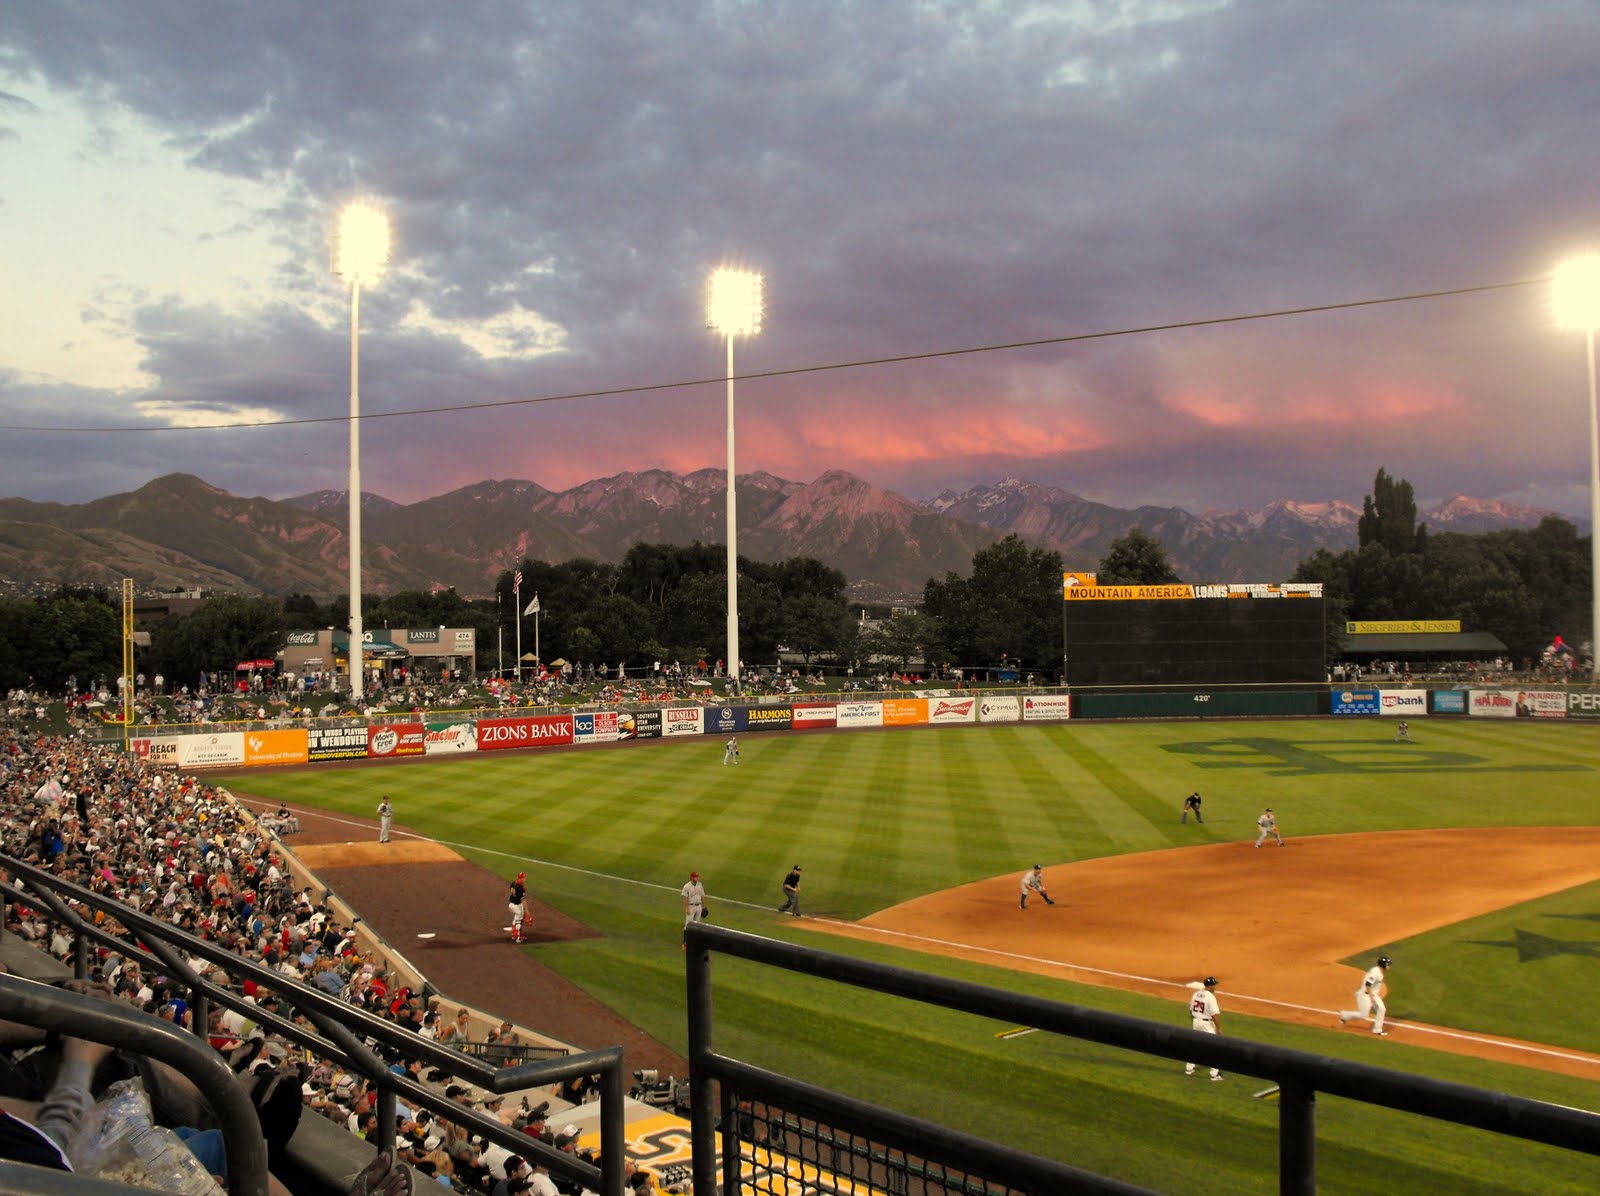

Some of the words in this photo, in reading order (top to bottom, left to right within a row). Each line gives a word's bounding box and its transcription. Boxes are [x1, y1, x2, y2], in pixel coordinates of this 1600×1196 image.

[1070, 587, 1132, 598] MOUNTAIN
[1138, 586, 1192, 598] AMERICA
[1194, 584, 1228, 598] LOANS
[1360, 622, 1409, 632] SIEGFRIED
[1410, 622, 1421, 631] &
[1424, 622, 1458, 632] JENSEN
[288, 632, 316, 644] Coca-Cola
[411, 631, 436, 639] LANTIS
[668, 710, 698, 721] RUSSELL'S
[748, 709, 792, 720] HARMONS
[374, 732, 394, 743] Move
[426, 729, 460, 742] Sinclair
[482, 726, 527, 742] ZIONS
[531, 722, 570, 738] BANK
[308, 737, 318, 748] IN
[320, 735, 368, 747] WENDOVER!
[377, 739, 393, 750] Free
[133, 739, 151, 757] U
[150, 744, 176, 754] REACH
[308, 751, 368, 760] WENDOVERFUN.COM
[1193, 1000, 1205, 1014] 29
